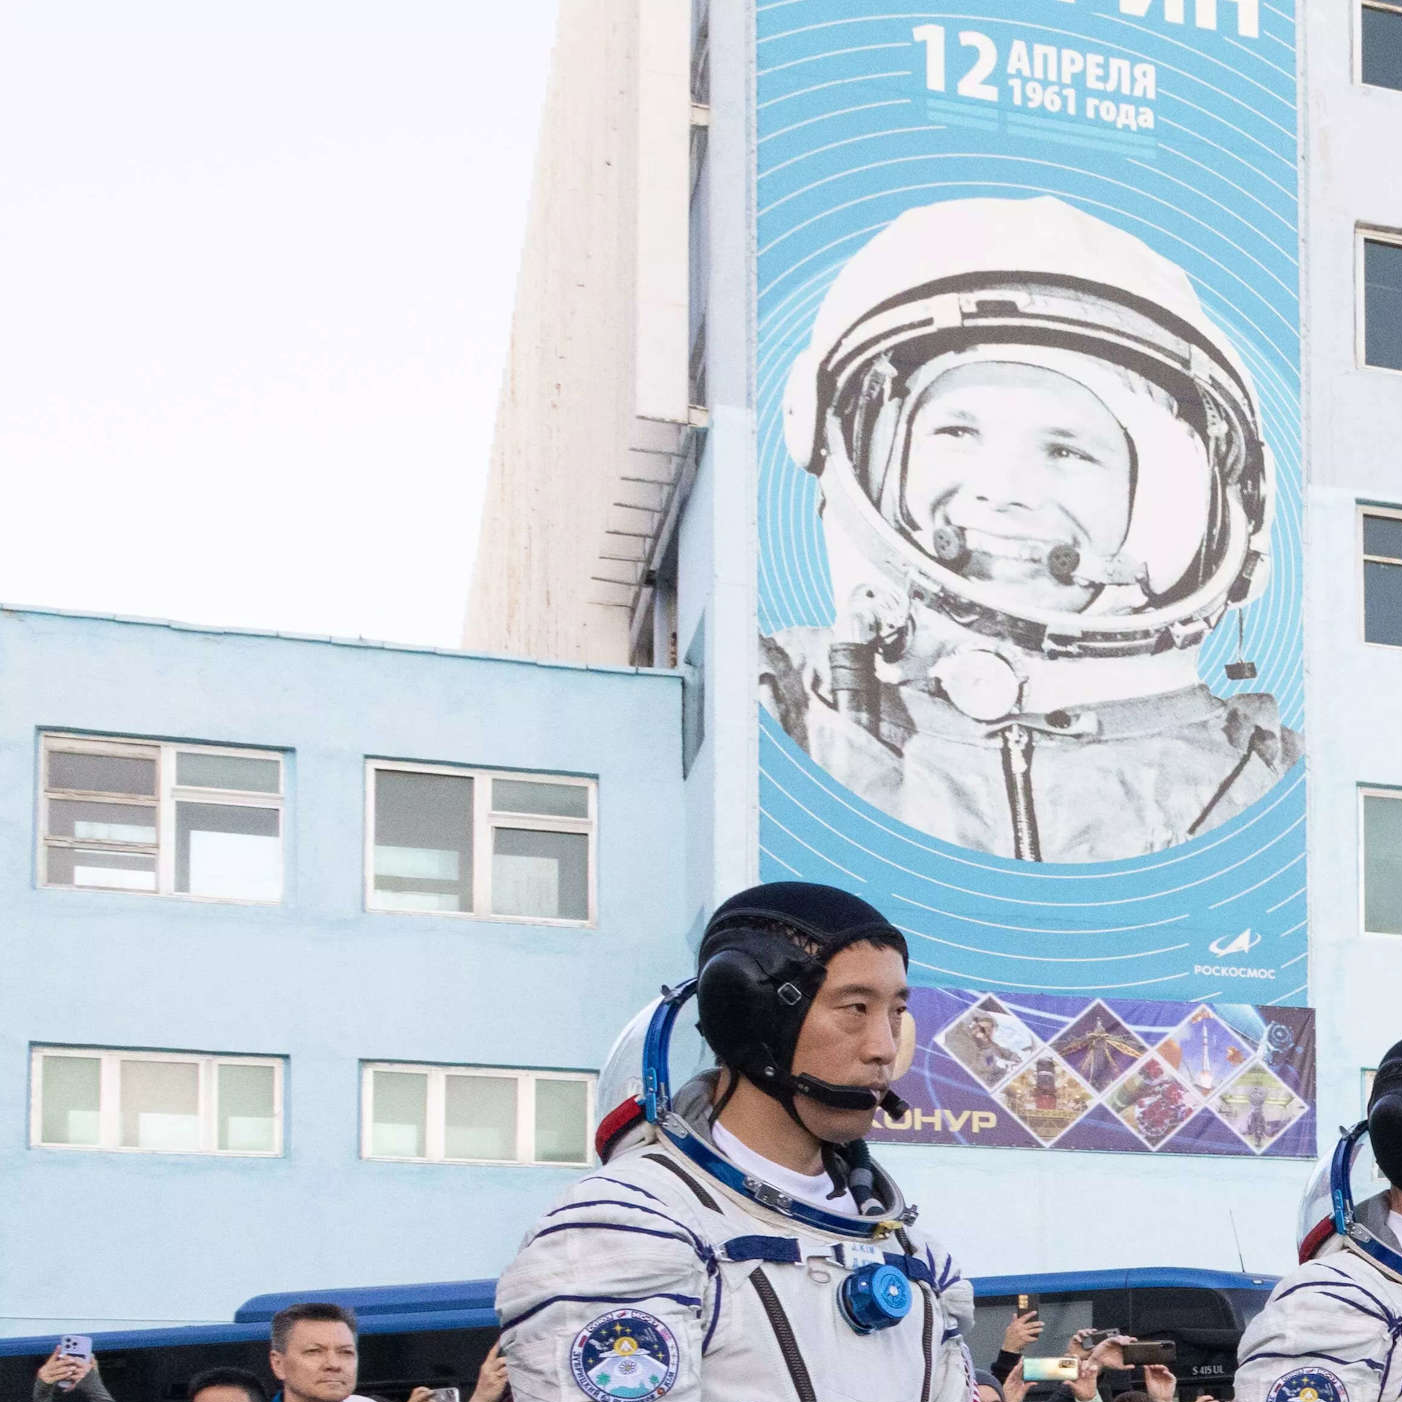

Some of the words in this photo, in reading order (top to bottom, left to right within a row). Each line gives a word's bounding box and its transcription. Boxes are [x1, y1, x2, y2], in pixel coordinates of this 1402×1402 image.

[912, 24, 999, 102] 12
[1007, 39, 1157, 100] АПРЕЛЯ
[1008, 78, 1077, 115] 1961
[1085, 97, 1155, 131] года
[1193, 964, 1277, 980] РОСКОСМОС
